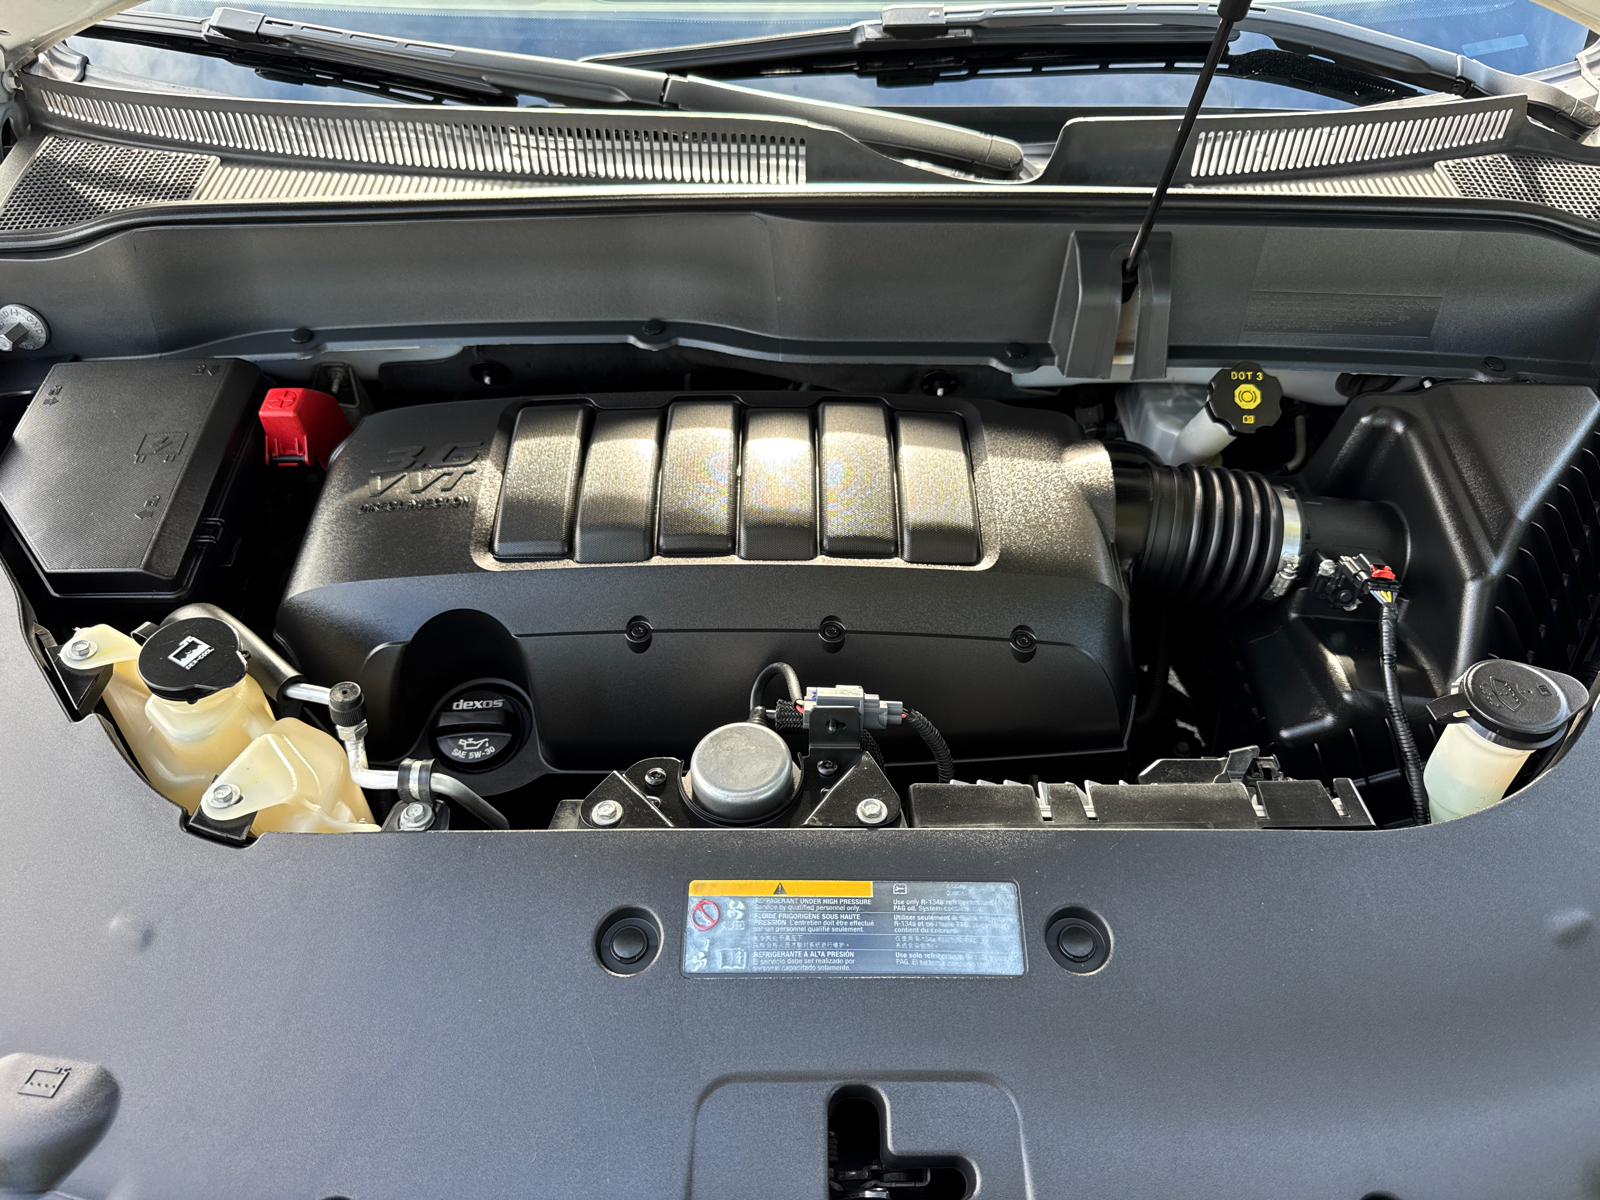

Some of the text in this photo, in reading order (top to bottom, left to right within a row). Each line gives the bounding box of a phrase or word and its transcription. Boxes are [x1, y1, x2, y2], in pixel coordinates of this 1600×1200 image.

[1230, 371, 1264, 381] DOT 3
[370, 442, 484, 473] 3.6
[368, 469, 477, 498] VVT
[452, 699, 506, 710] dexos
[452, 746, 496, 759] SAE 5W-30
